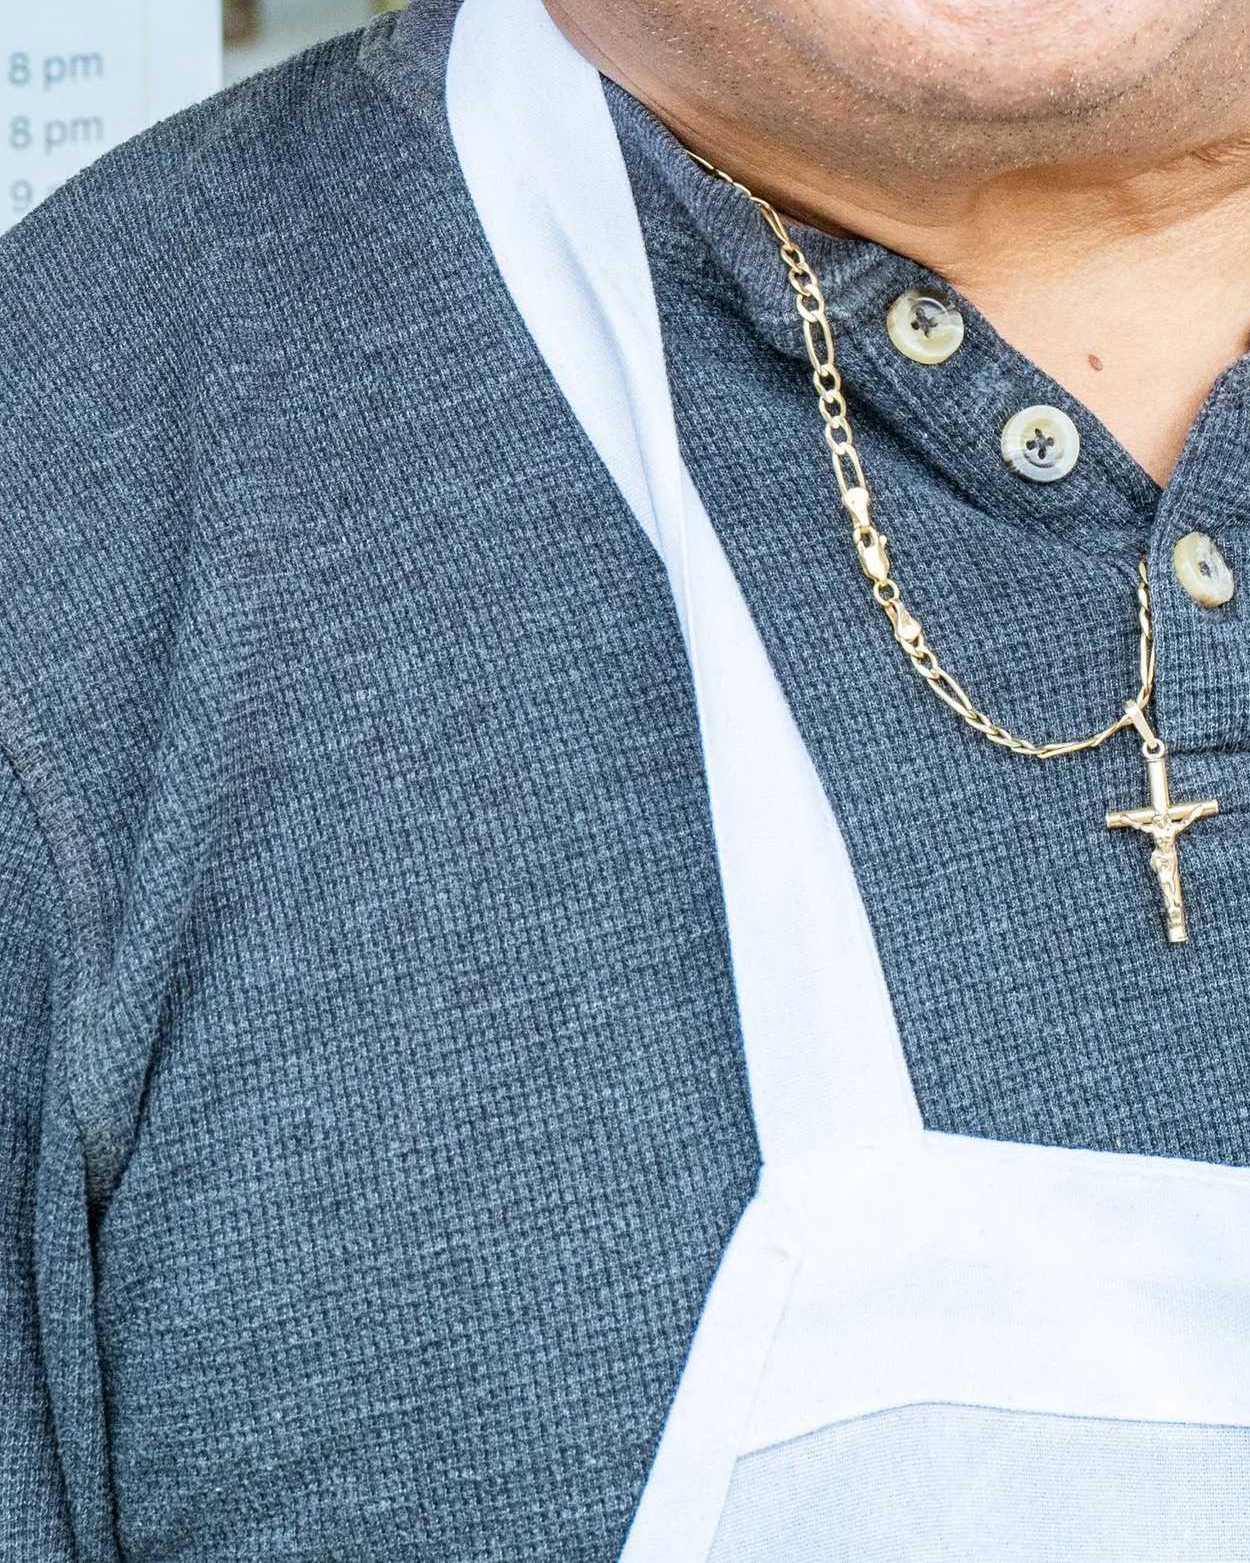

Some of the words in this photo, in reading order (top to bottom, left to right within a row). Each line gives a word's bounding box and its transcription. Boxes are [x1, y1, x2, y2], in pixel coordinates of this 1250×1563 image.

[8, 51, 31, 86] 8
[43, 51, 104, 93] pm
[9, 115, 33, 151] 8
[44, 115, 104, 156] pm
[9, 179, 34, 213] 9
